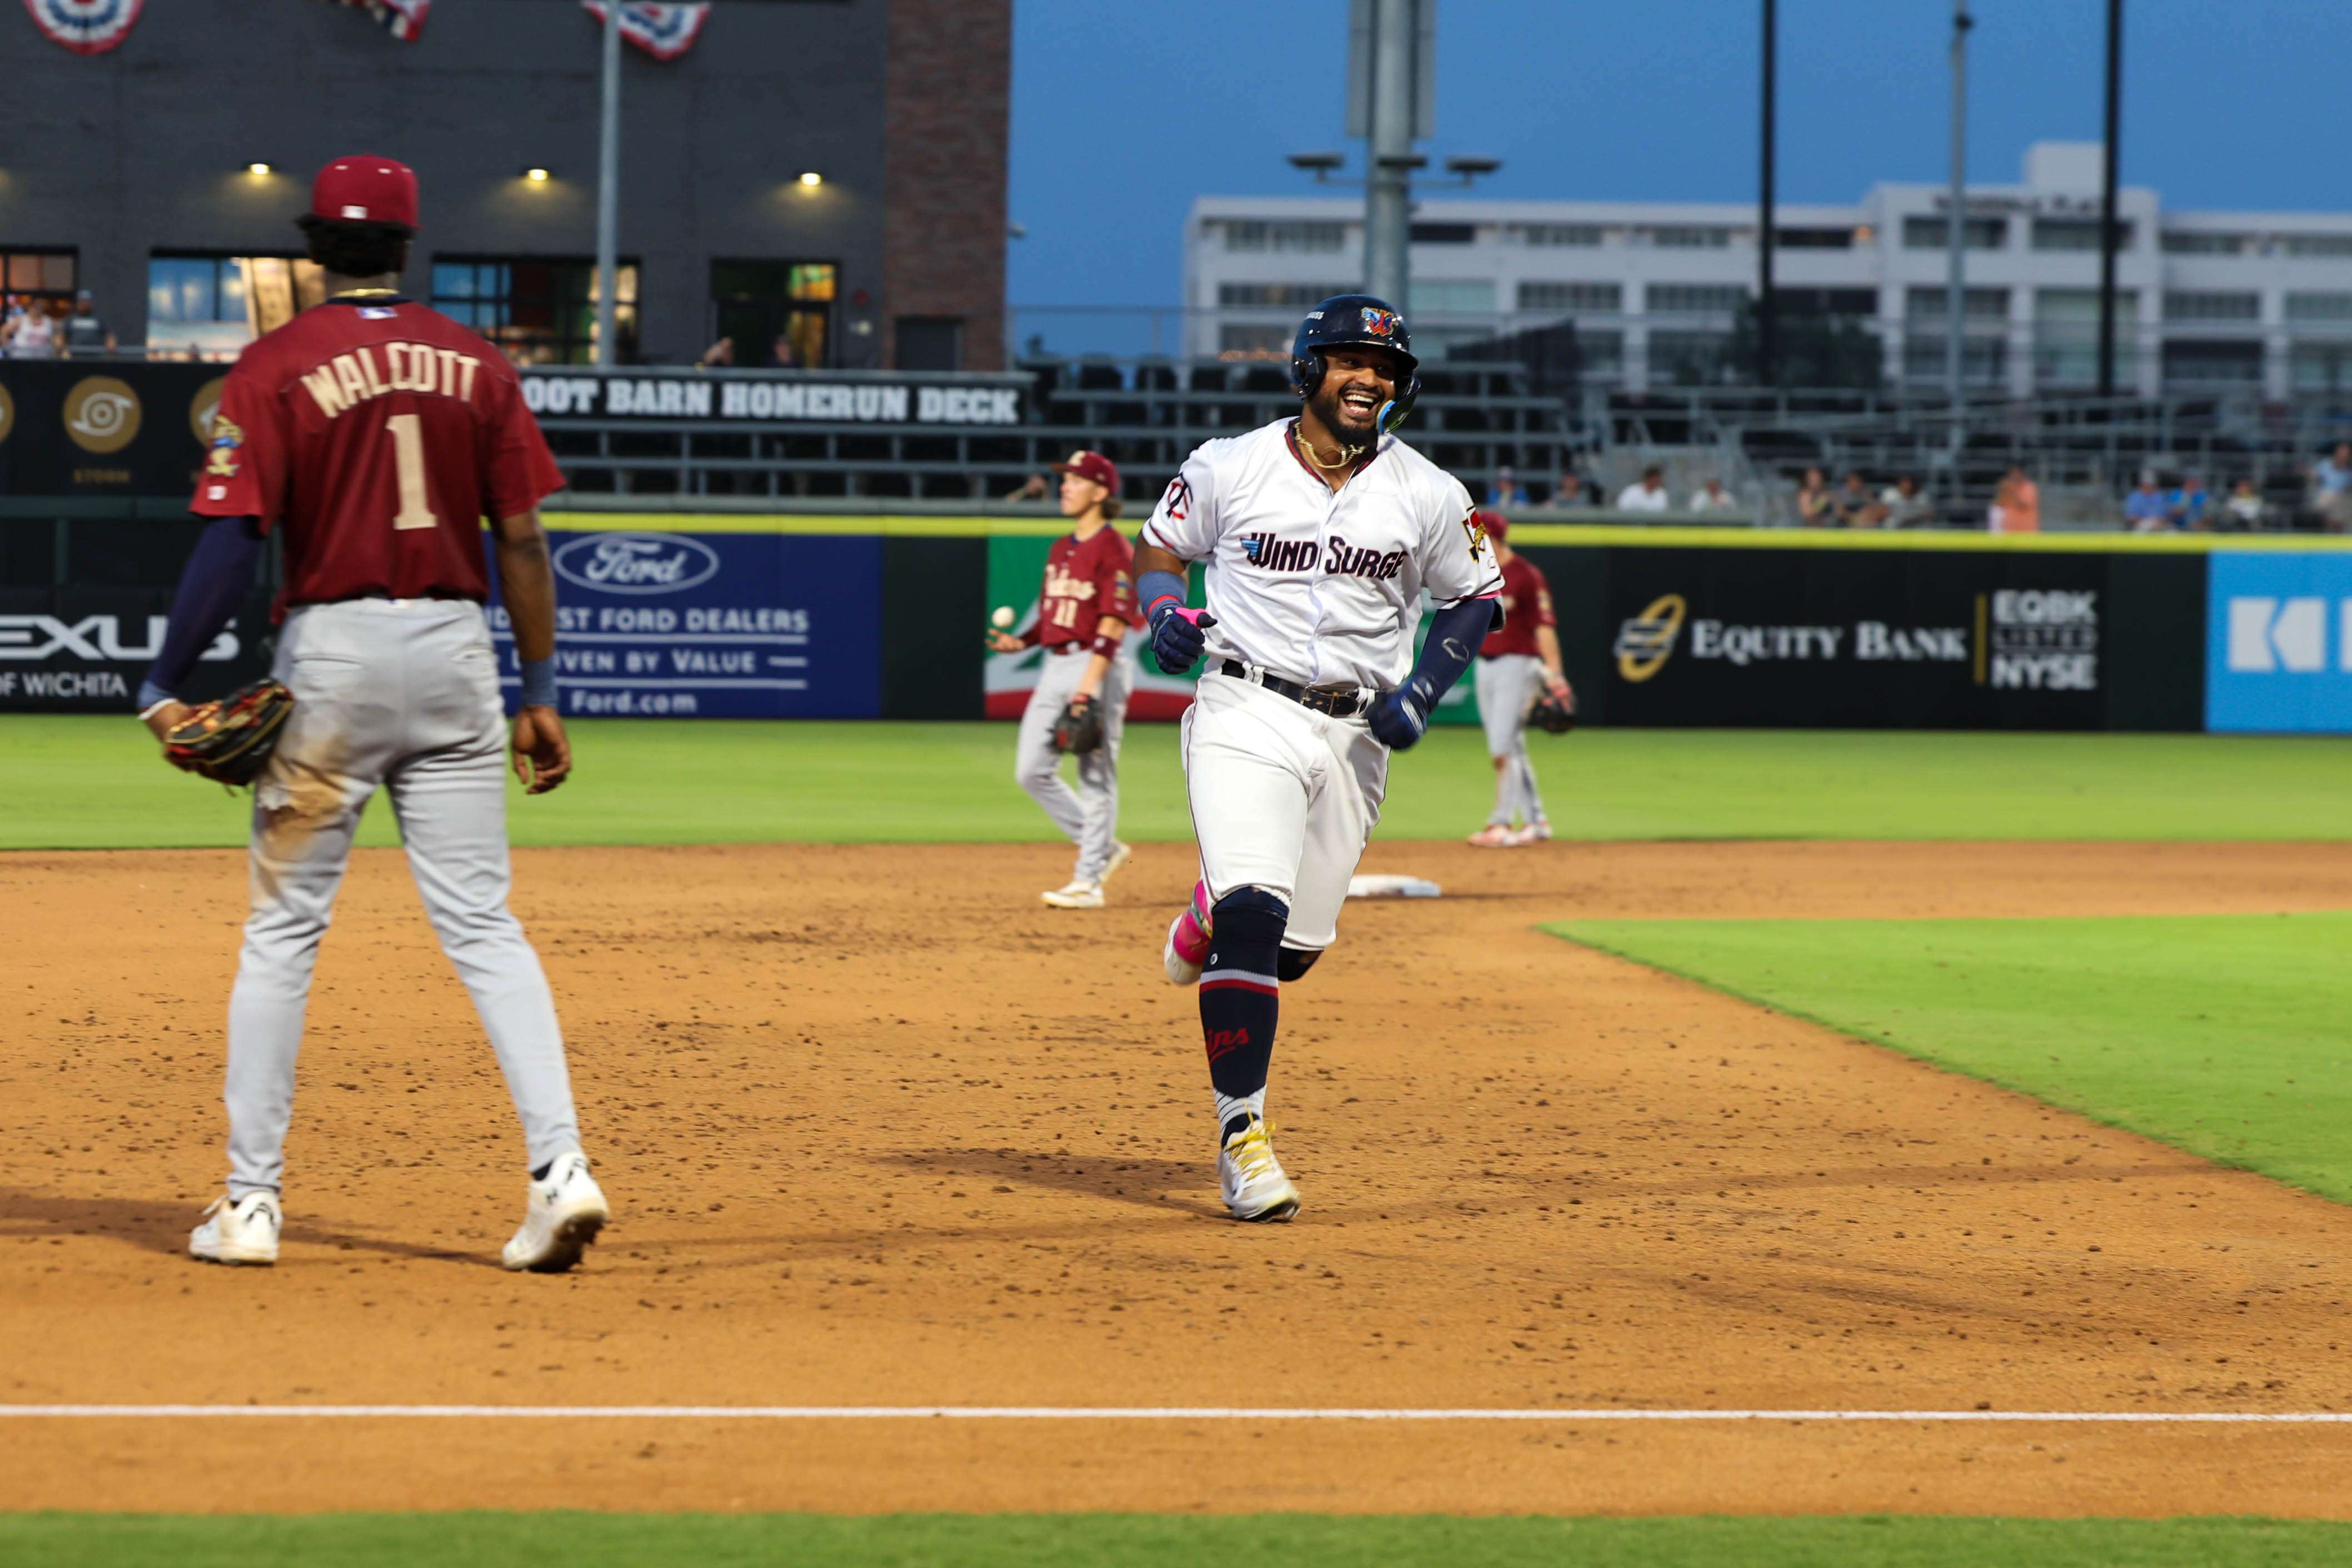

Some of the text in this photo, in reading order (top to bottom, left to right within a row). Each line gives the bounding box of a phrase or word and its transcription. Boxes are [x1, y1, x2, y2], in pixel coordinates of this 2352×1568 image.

[300, 341, 480, 419] WALCOTT
[521, 377, 1018, 423] OOT BARN HOMERUN DECK
[386, 413, 437, 530] 1
[586, 539, 687, 582] Ford
[600, 608, 677, 632] FORD
[686, 608, 809, 633] DEALERS
[1052, 599, 1078, 628] 11
[1993, 589, 2097, 624] EQBK
[625, 651, 660, 672] BY
[1992, 654, 2097, 690] NYSE
[22, 672, 128, 697] WICHITA
[572, 690, 697, 713] Ford.com
[1206, 1028, 1250, 1053] ins
